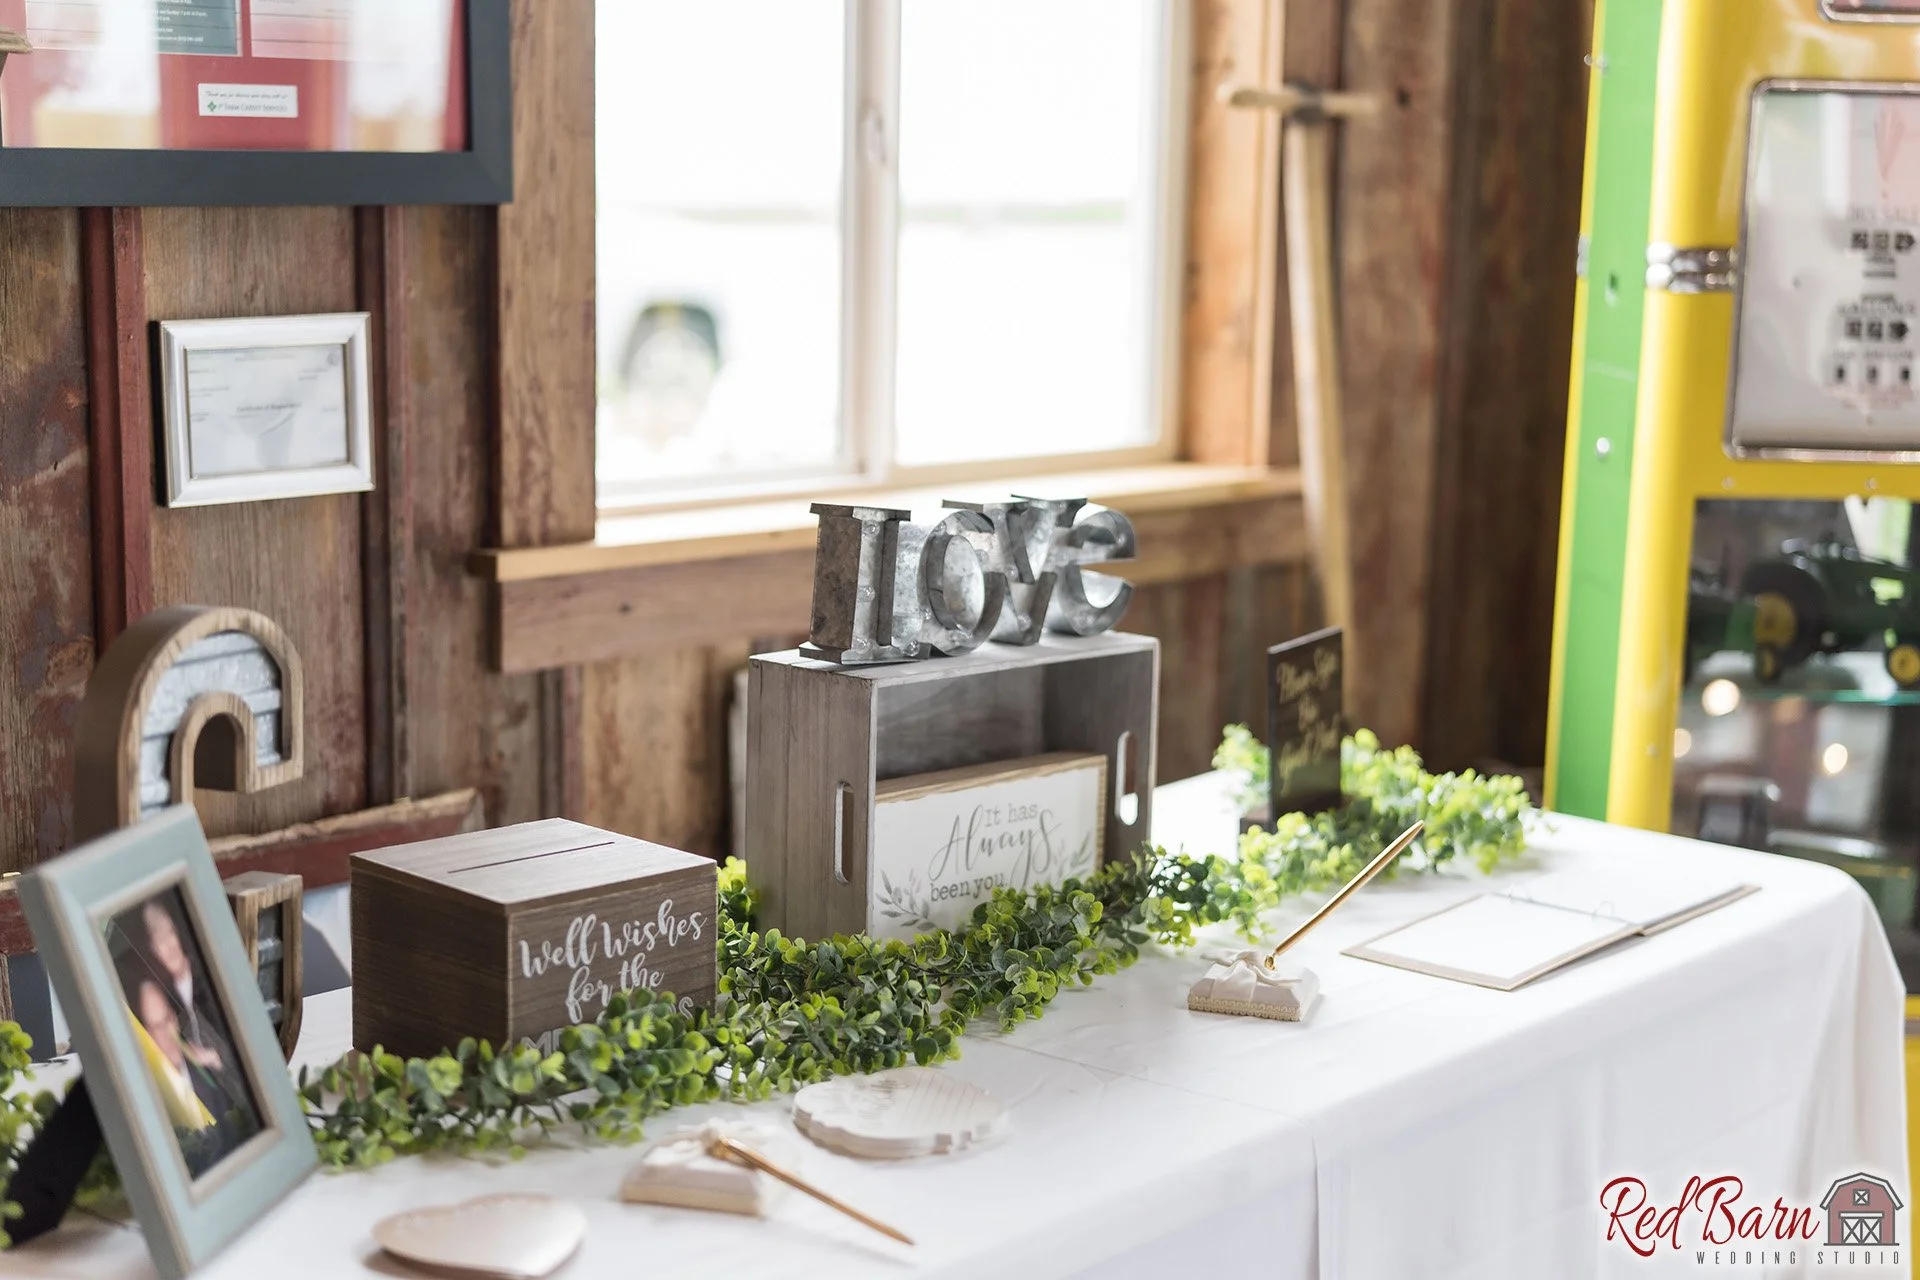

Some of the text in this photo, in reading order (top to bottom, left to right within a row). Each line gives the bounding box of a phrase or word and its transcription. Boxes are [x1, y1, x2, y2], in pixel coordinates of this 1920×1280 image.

[984, 802, 1038, 827] It has
[930, 880, 970, 902] been
[519, 898, 708, 979] Well Wishes
[565, 965, 614, 1025] for
[617, 952, 665, 995] the
